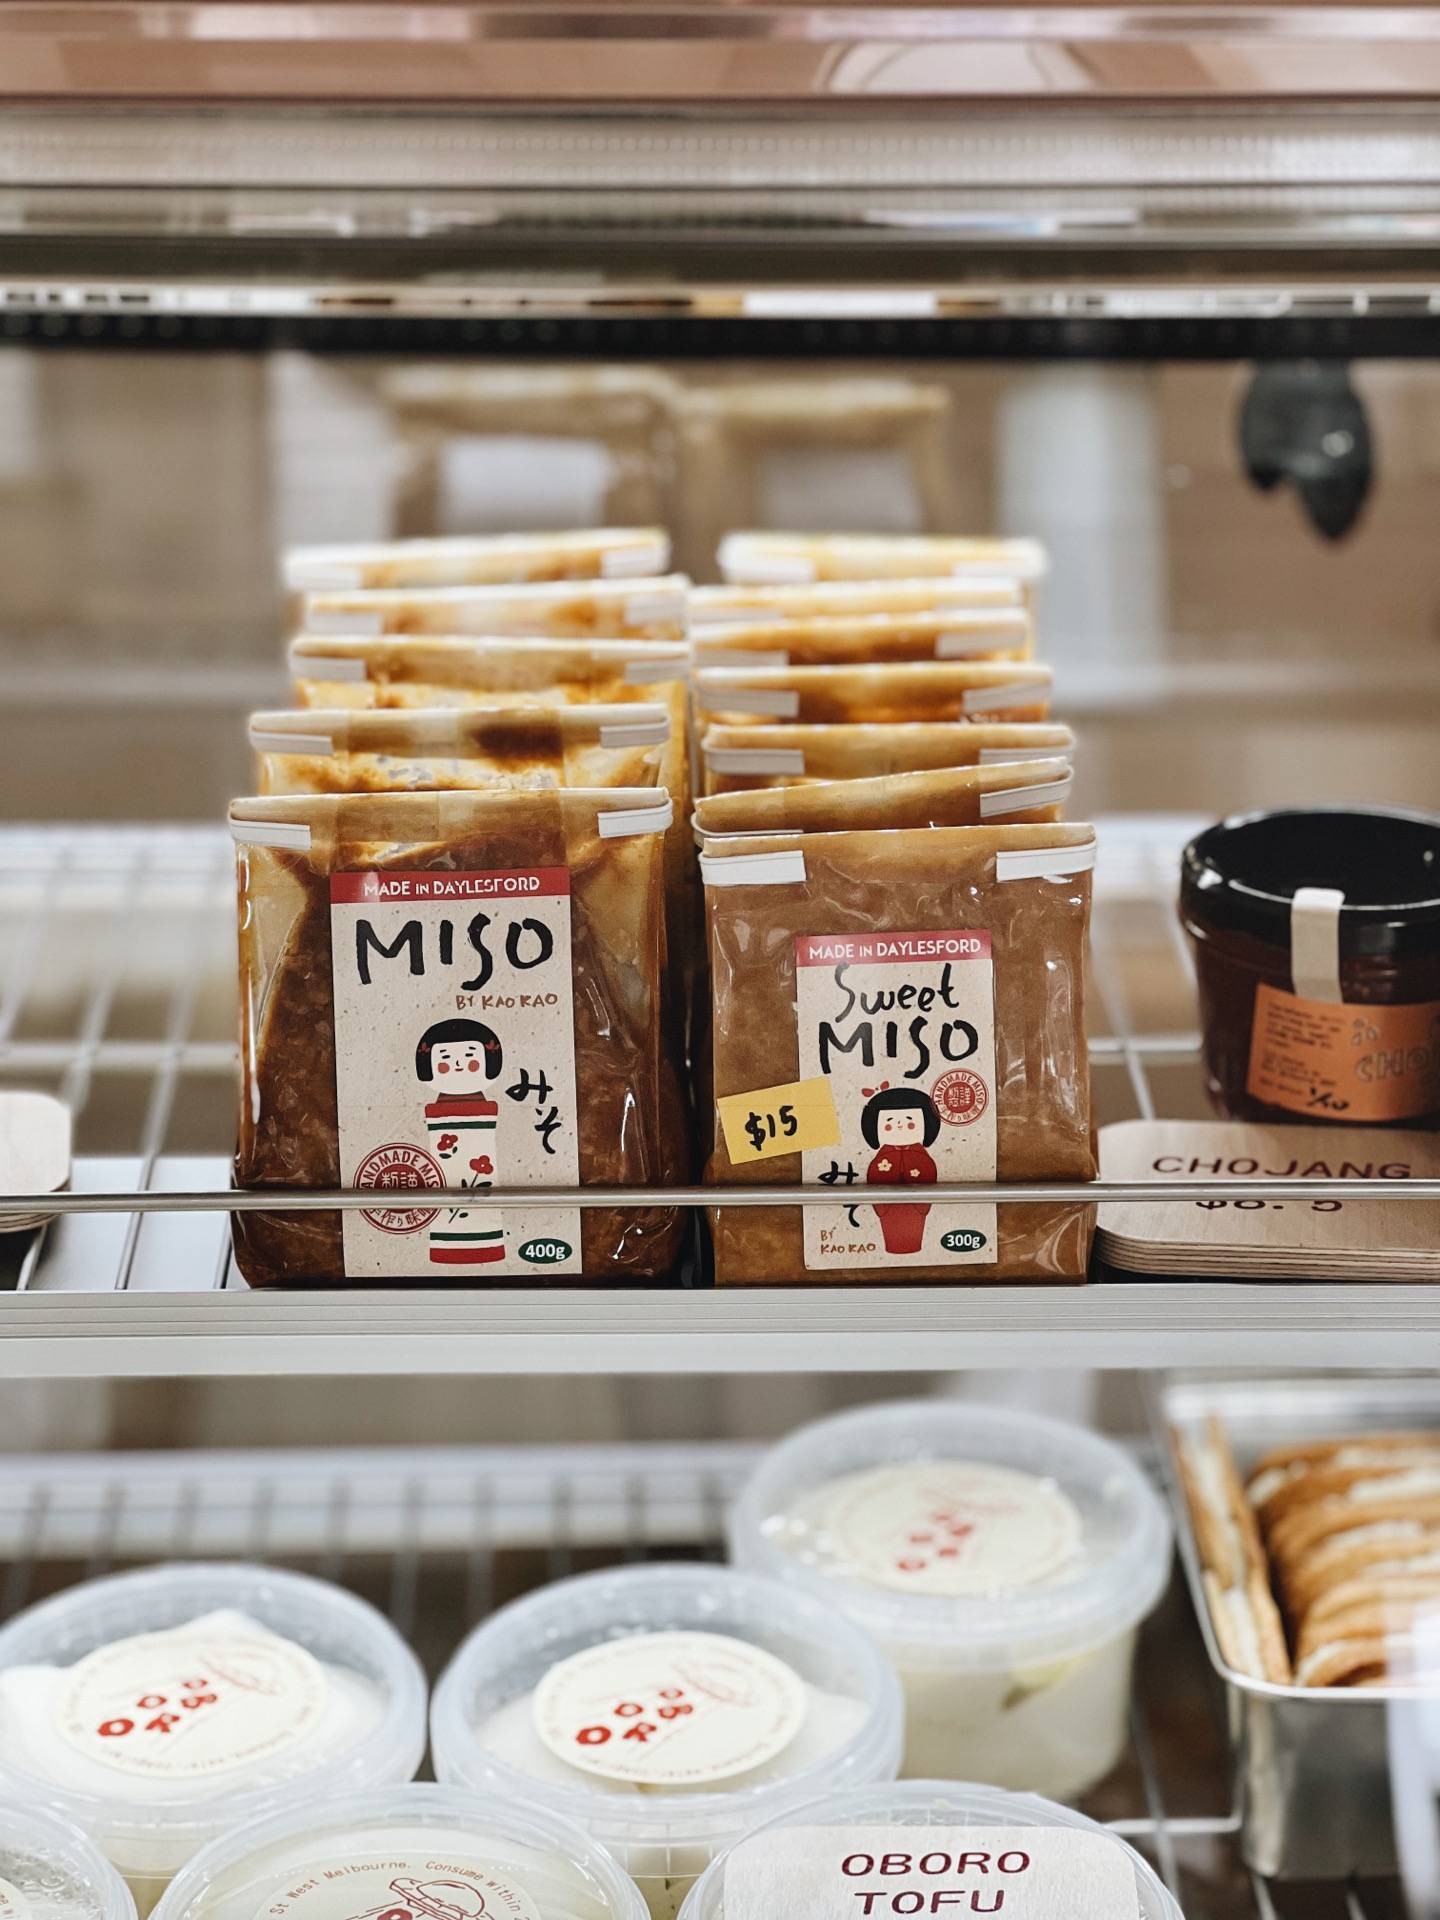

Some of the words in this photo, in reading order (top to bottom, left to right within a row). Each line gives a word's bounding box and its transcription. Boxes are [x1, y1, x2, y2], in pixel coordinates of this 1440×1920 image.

[364, 880, 411, 897] MADE
[433, 876, 541, 896] DAYLESFORD
[356, 912, 554, 991] MISO
[809, 943, 855, 960] MADE
[876, 938, 981, 957] DAYLESFORD
[456, 994, 474, 1010] BY
[482, 994, 515, 1009] KAO
[520, 992, 558, 1008] KAO
[834, 961, 960, 1023] Sweet
[818, 1015, 979, 1080] MISO
[505, 1068, 562, 1155] みそ
[744, 1105, 798, 1151] $15
[360, 1150, 421, 1189] ANDMADE
[418, 1162, 440, 1189] MIS
[1152, 1156, 1412, 1180] CHOJANG
[525, 1243, 566, 1260] 400g
[820, 1243, 846, 1255] KAO
[946, 1233, 981, 1249] 300g
[841, 1851, 1030, 1876] OBORO
[286, 1879, 320, 1899] West
[425, 1860, 485, 1881] Consume
[486, 1880, 521, 1912] within
[854, 1889, 1005, 1915] TOFU
